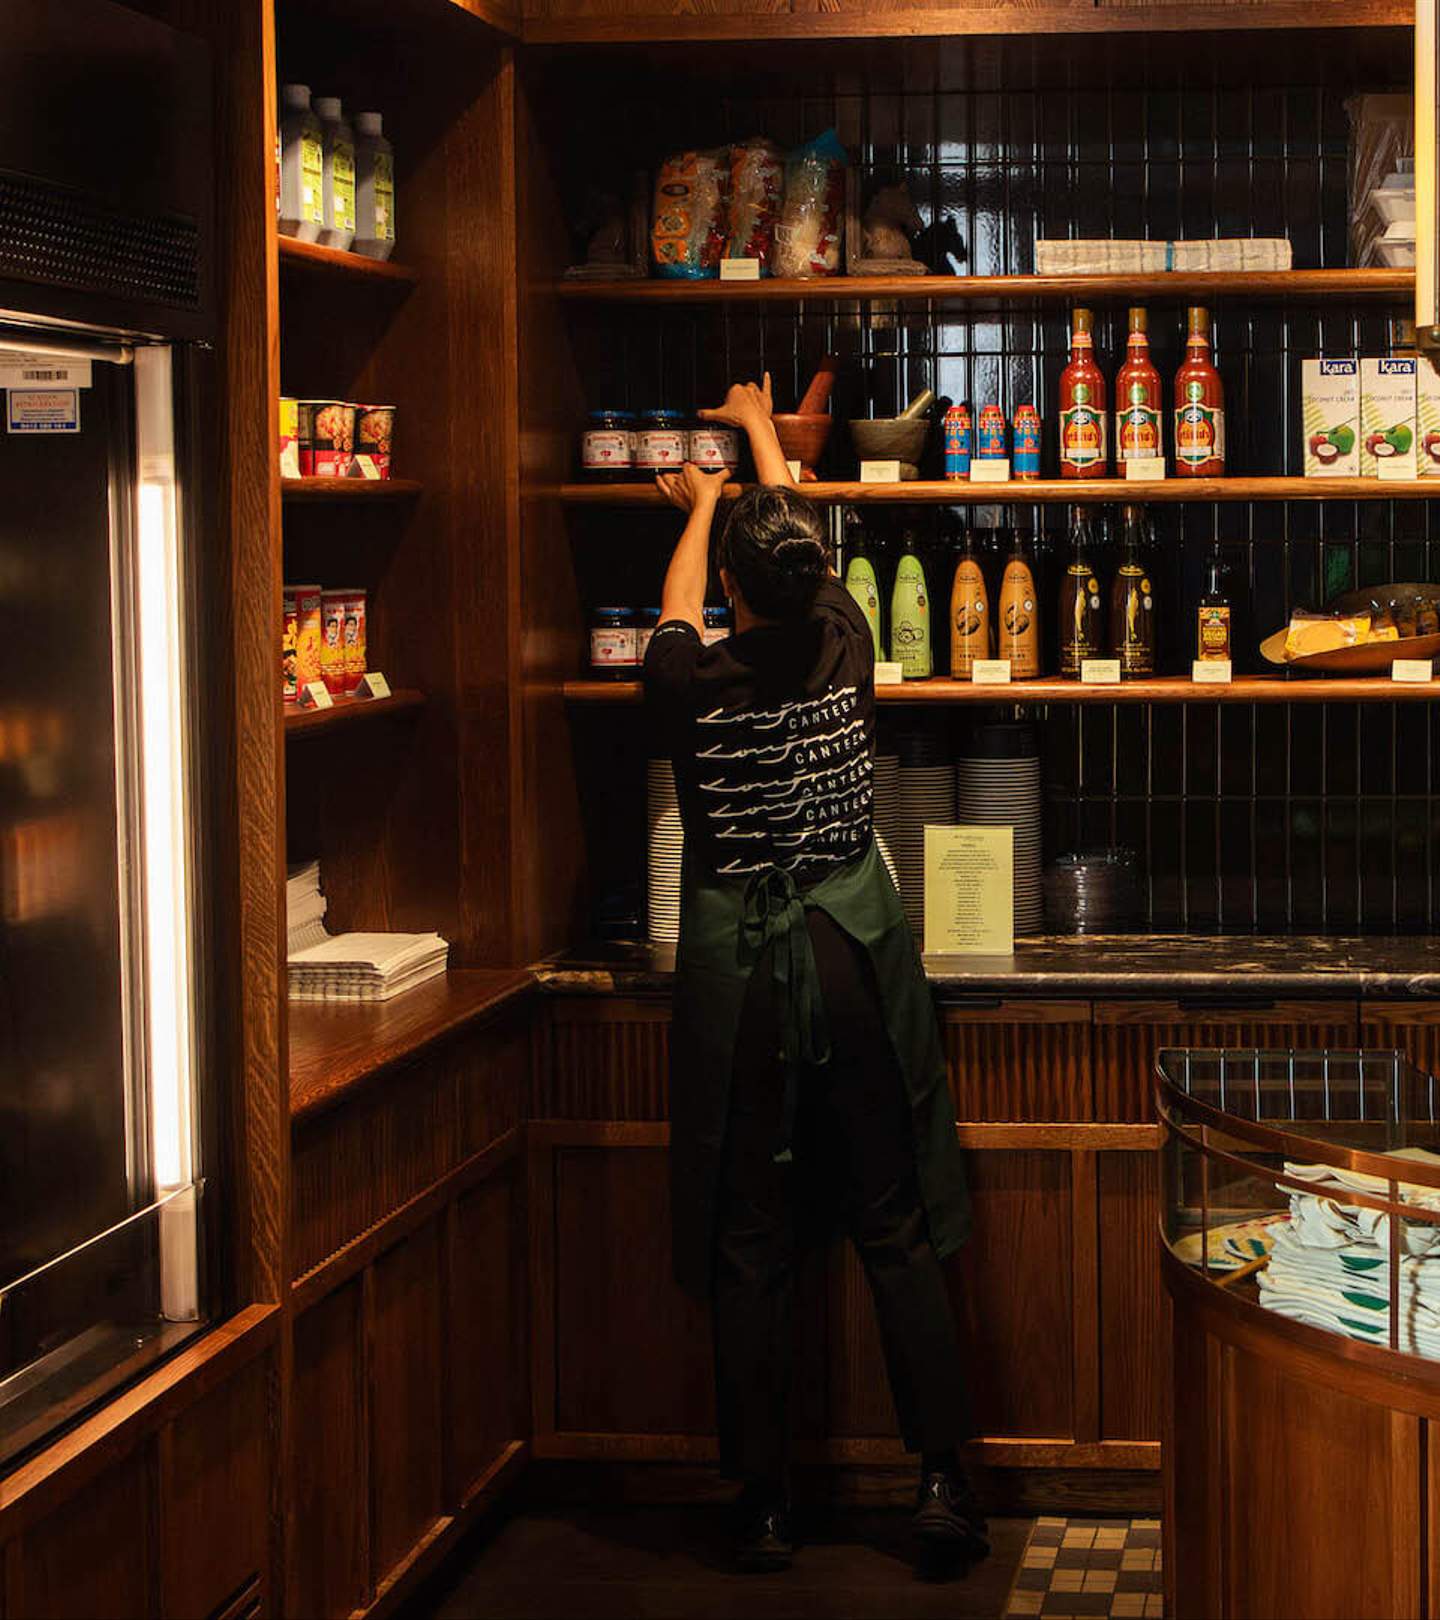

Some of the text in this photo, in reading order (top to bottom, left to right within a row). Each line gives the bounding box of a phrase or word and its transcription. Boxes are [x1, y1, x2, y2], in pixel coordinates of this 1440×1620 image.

[1322, 360, 1354, 375] kara
[1380, 359, 1412, 374] kara
[788, 696, 858, 730] CANTEEN
[795, 731, 867, 765] CANTEEN
[802, 760, 874, 797] CANTEEN
[806, 788, 874, 821] CANTEEN
